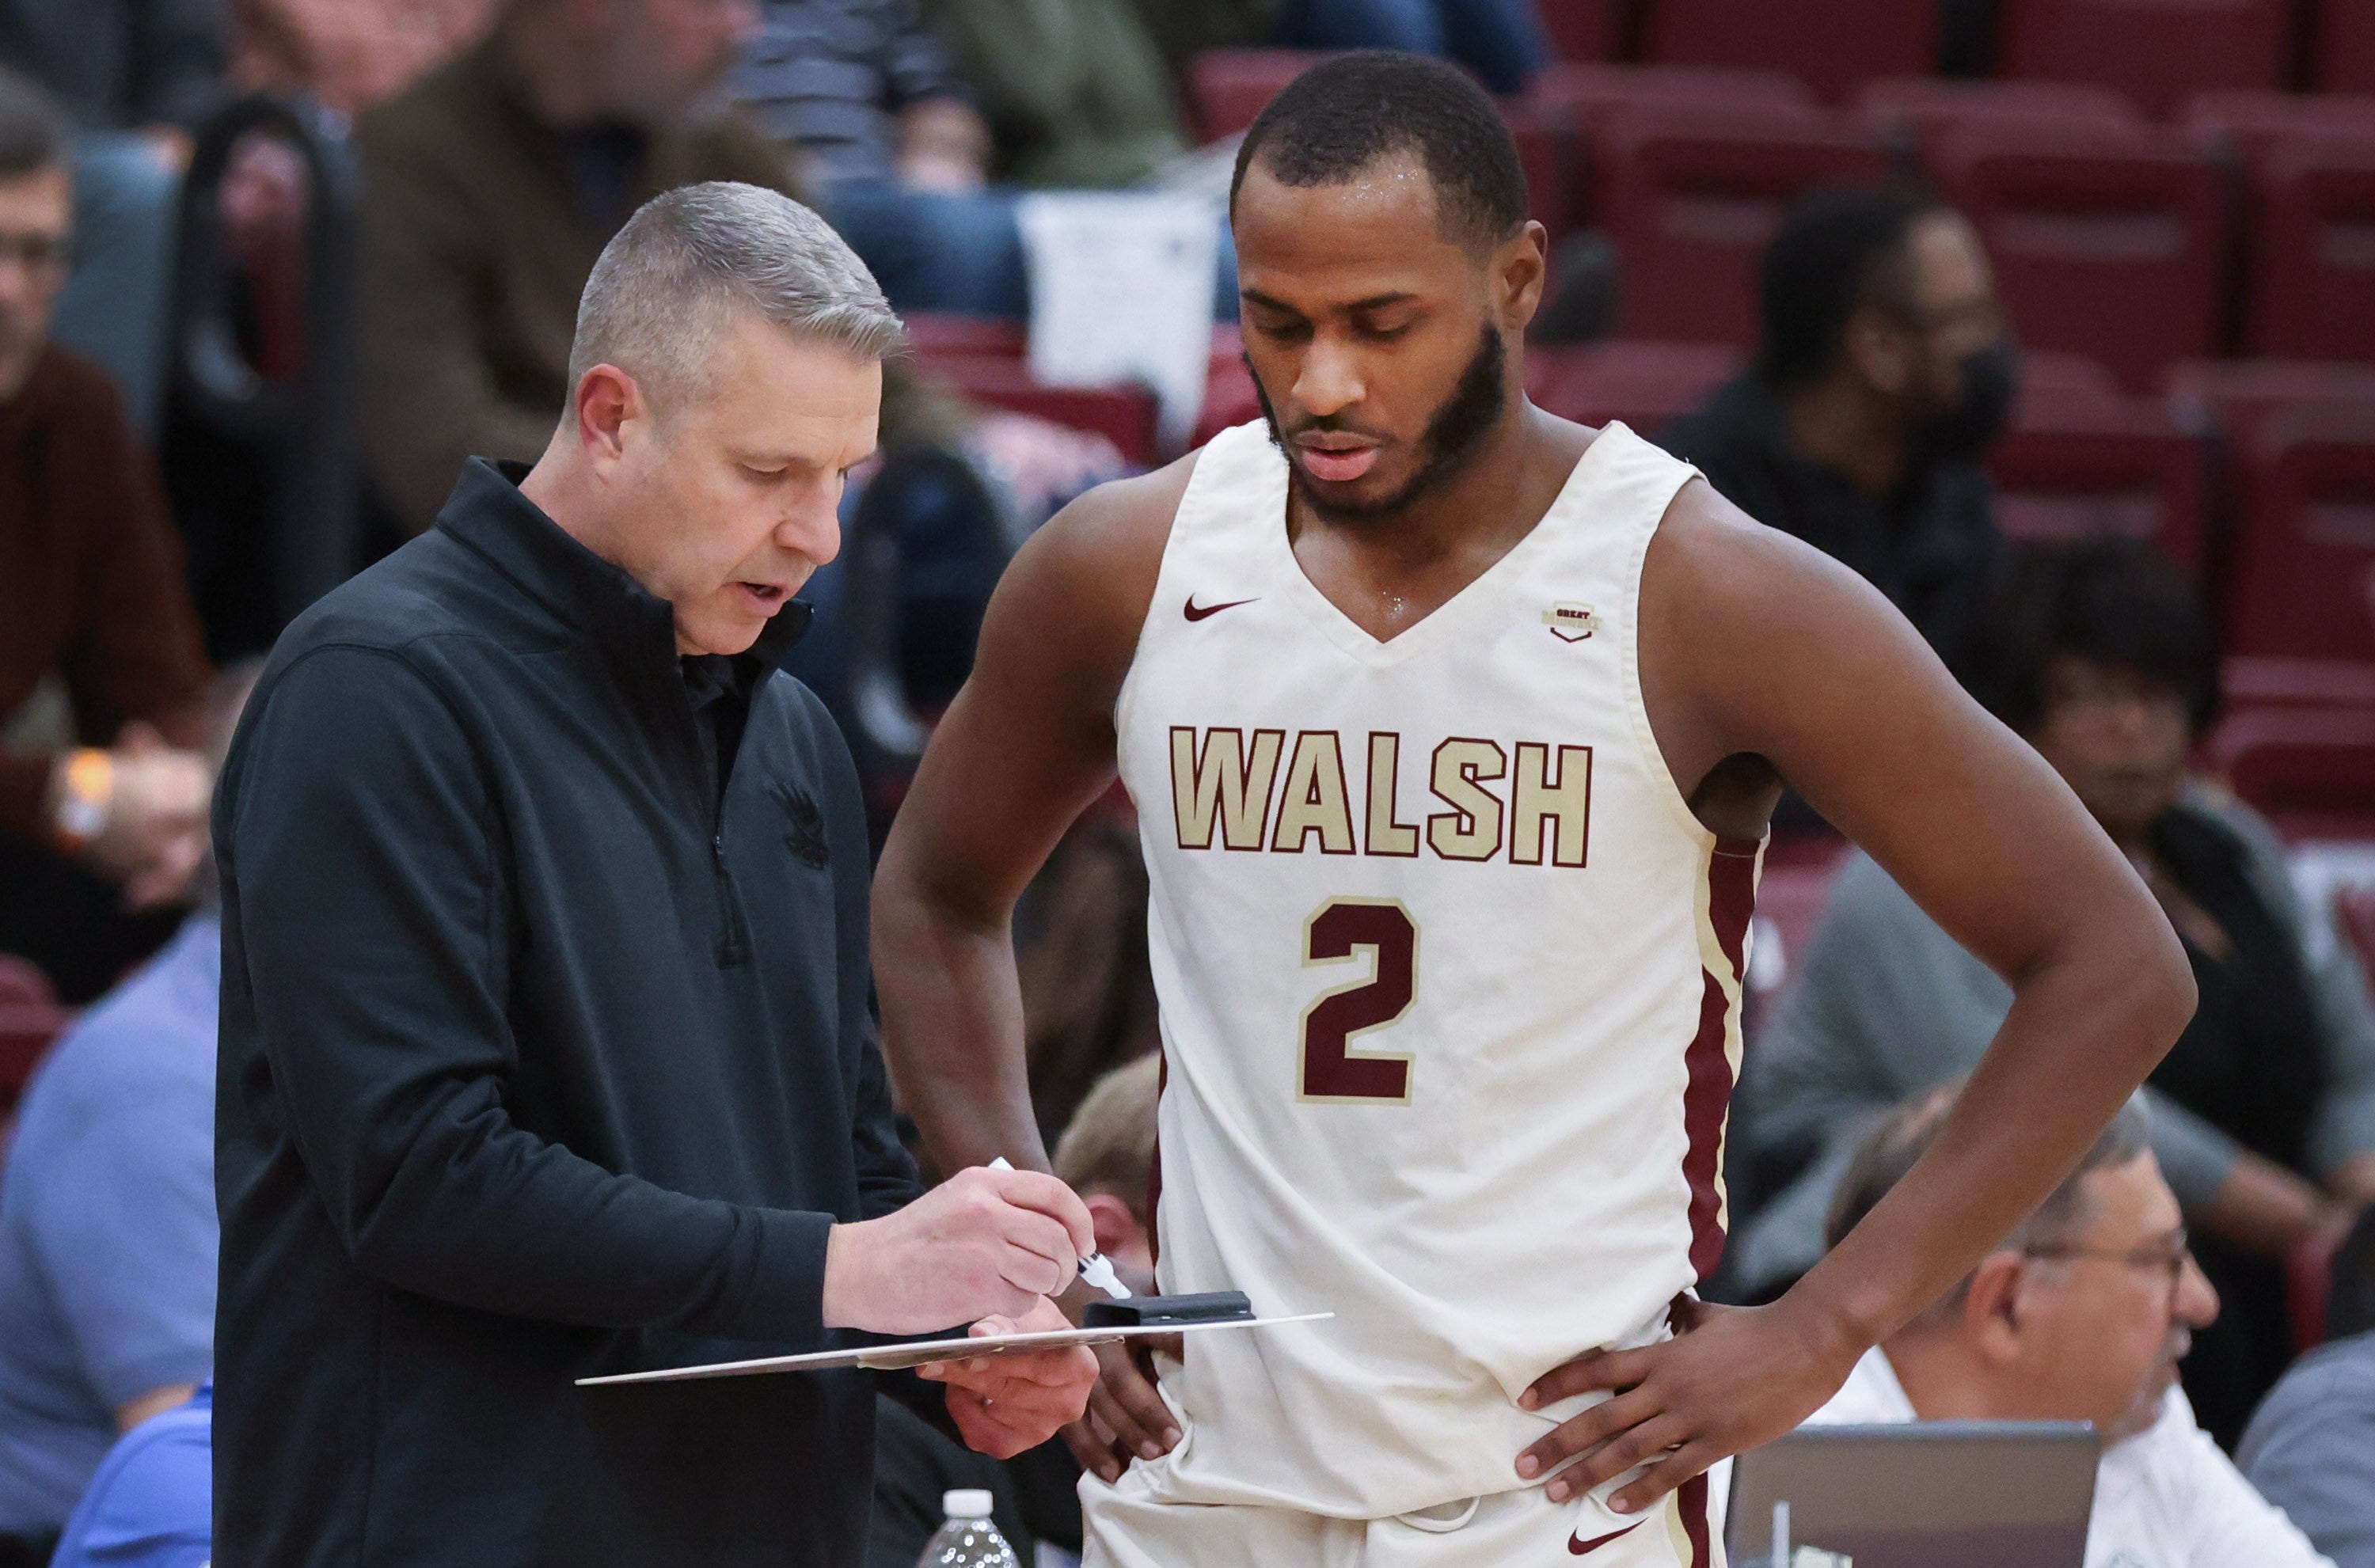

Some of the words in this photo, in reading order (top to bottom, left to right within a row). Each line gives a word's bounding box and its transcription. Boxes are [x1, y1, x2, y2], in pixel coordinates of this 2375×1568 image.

[1556, 609, 1590, 620] GREAT
[1169, 726, 1593, 868] WALSH
[1295, 895, 1421, 1106] 2
